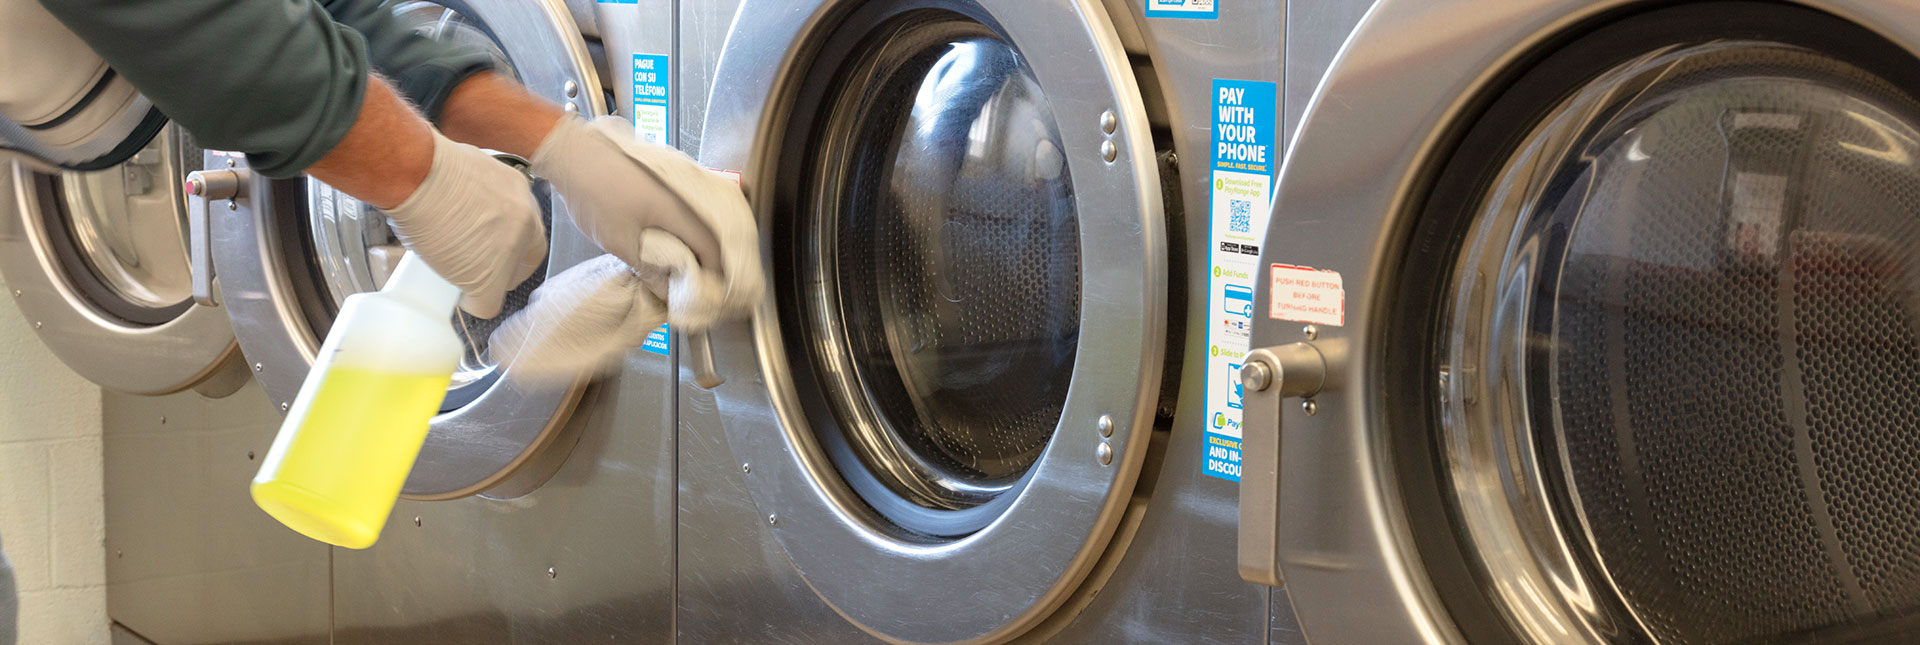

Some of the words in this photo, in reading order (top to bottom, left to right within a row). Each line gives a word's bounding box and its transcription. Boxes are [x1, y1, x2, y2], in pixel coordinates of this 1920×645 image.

[635, 59, 654, 69] PAGUE
[635, 72, 647, 82] CON
[648, 73, 656, 82] SU
[635, 83, 665, 96] TELÉFONO
[1219, 87, 1245, 105] PAY
[1218, 105, 1254, 125] WITH
[1218, 123, 1256, 143] YOUR
[1218, 142, 1266, 163] PHONE
[1217, 161, 1235, 169] SIMPLE.
[1225, 177, 1250, 187] Download
[1251, 180, 1262, 188] Free
[1225, 186, 1249, 197] PayRange
[1250, 189, 1260, 197] App
[1223, 269, 1233, 277] Add
[1233, 270, 1248, 279] Funds
[1275, 277, 1294, 285] PUSH
[1296, 279, 1310, 287] RED
[1311, 281, 1340, 290] BUTTON
[1293, 291, 1320, 302] BEFORE
[1308, 306, 1337, 315] HANDLE
[1220, 348, 1233, 358] Slide
[1209, 436, 1238, 449] EXCLUSIVE
[1209, 446, 1228, 460] AND
[1229, 450, 1242, 463] IN-
[1208, 459, 1242, 477] DISCOU
